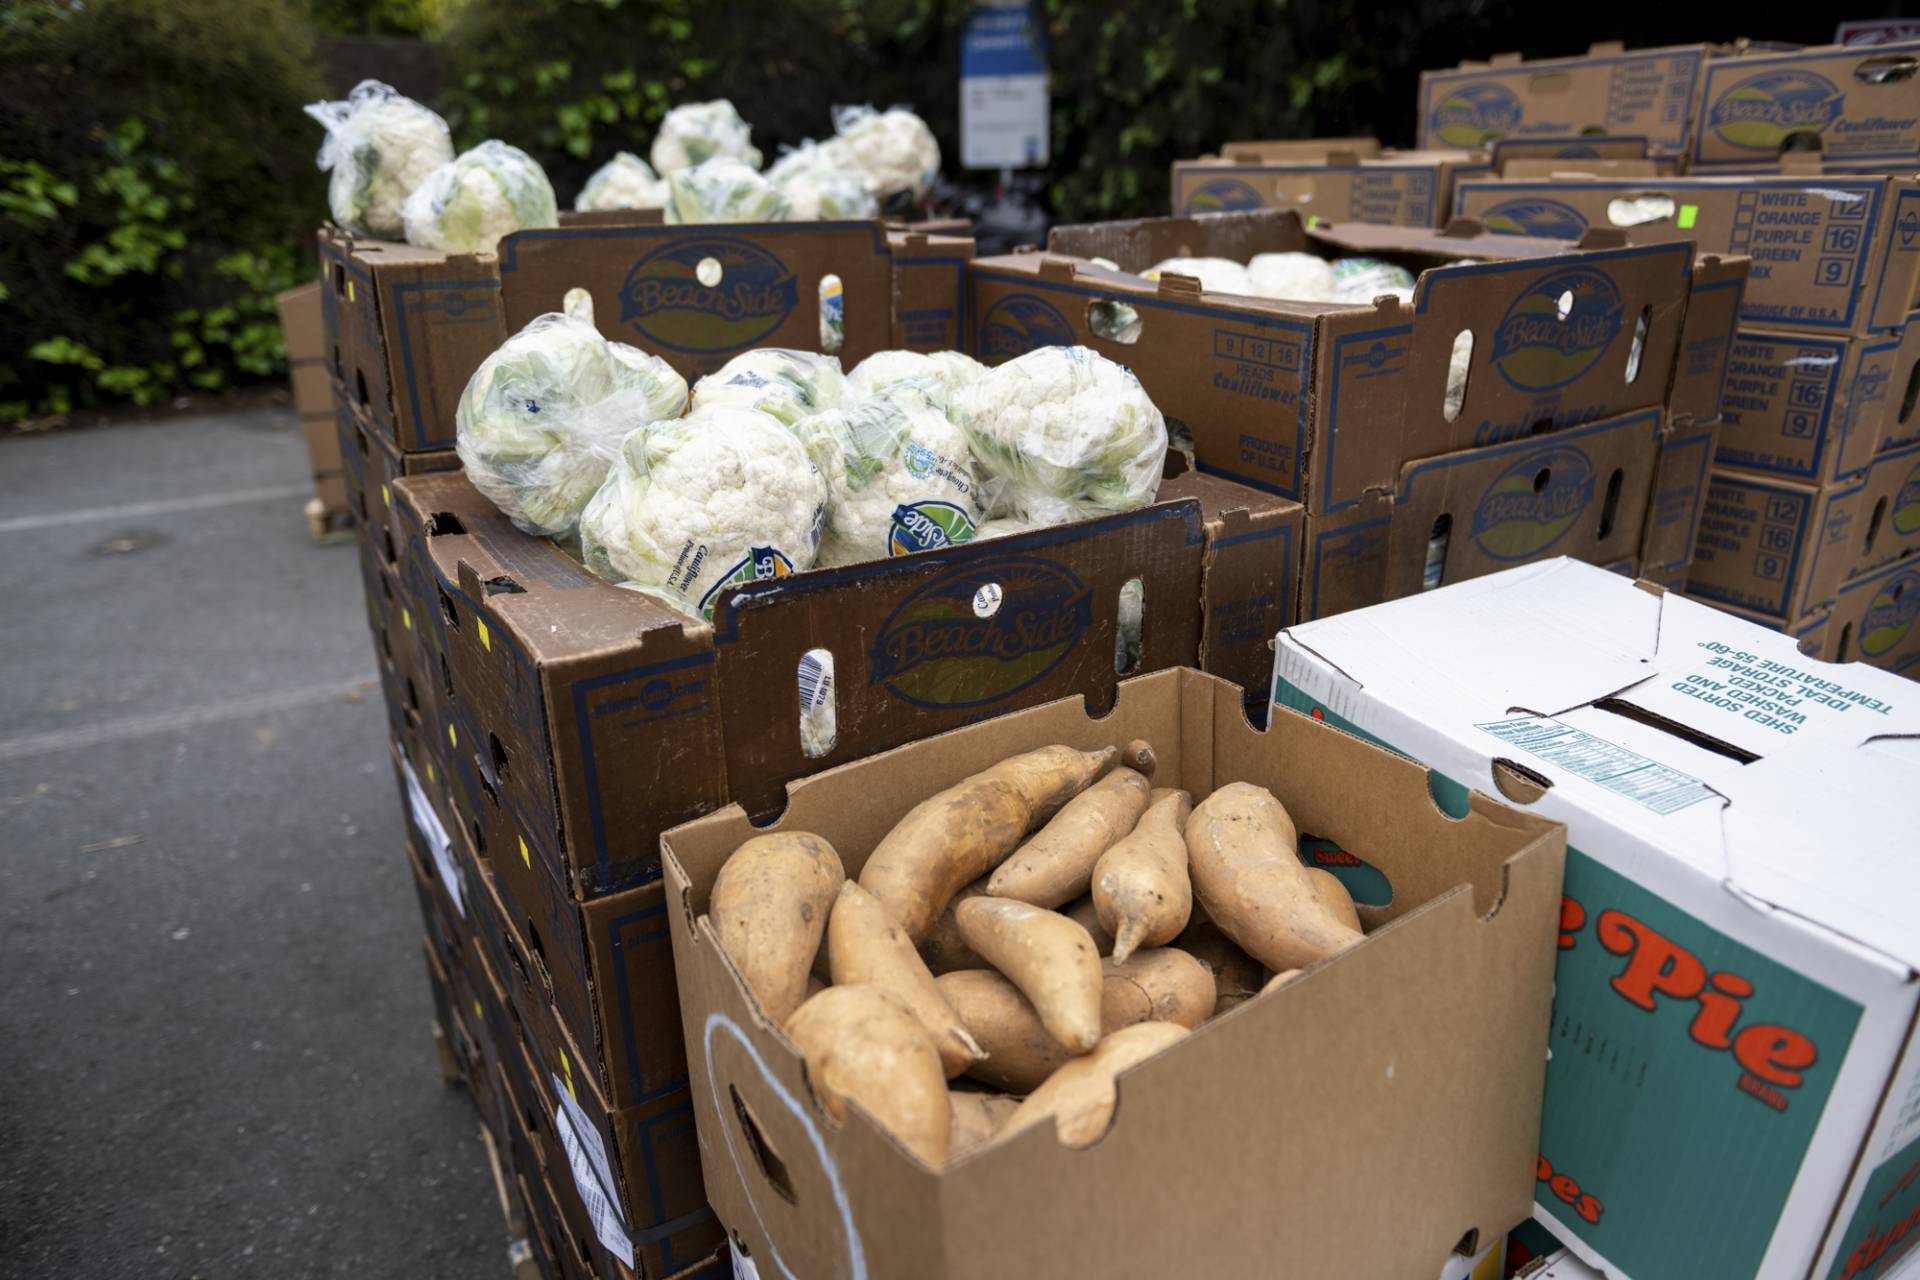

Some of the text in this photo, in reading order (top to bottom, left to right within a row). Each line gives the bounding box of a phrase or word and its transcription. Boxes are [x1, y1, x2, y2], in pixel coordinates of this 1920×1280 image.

[1760, 192, 1808, 207] WHITE
[1756, 211, 1822, 226] ORANGE
[1754, 230, 1814, 245] PURPLE
[1829, 229, 1857, 250] 16
[1751, 248, 1802, 263] GREEN
[1825, 261, 1843, 283] 9
[1740, 303, 1787, 317] RODUCE
[1250, 343, 1265, 358] 12
[1236, 363, 1275, 382] HEADS
[1213, 370, 1297, 405] Cauliflower
[1795, 384, 1820, 404] 16
[1791, 415, 1808, 434] 9
[1239, 434, 1292, 459] PRODUCE
[1240, 449, 1256, 463] OF
[1773, 501, 1796, 518] 12
[1767, 532, 1791, 550] 16
[681, 544, 710, 593] Cauliflower
[1763, 558, 1777, 577] 9
[1706, 656, 1852, 712] IDEAL STORAGE
[1727, 674, 1803, 707] PACKED.
[1758, 659, 1894, 716] TEMPERATURE
[1671, 681, 1799, 735] SHED SORTED
[1685, 674, 1808, 725] WASHED AND
[1596, 907, 1819, 1090] Pie
